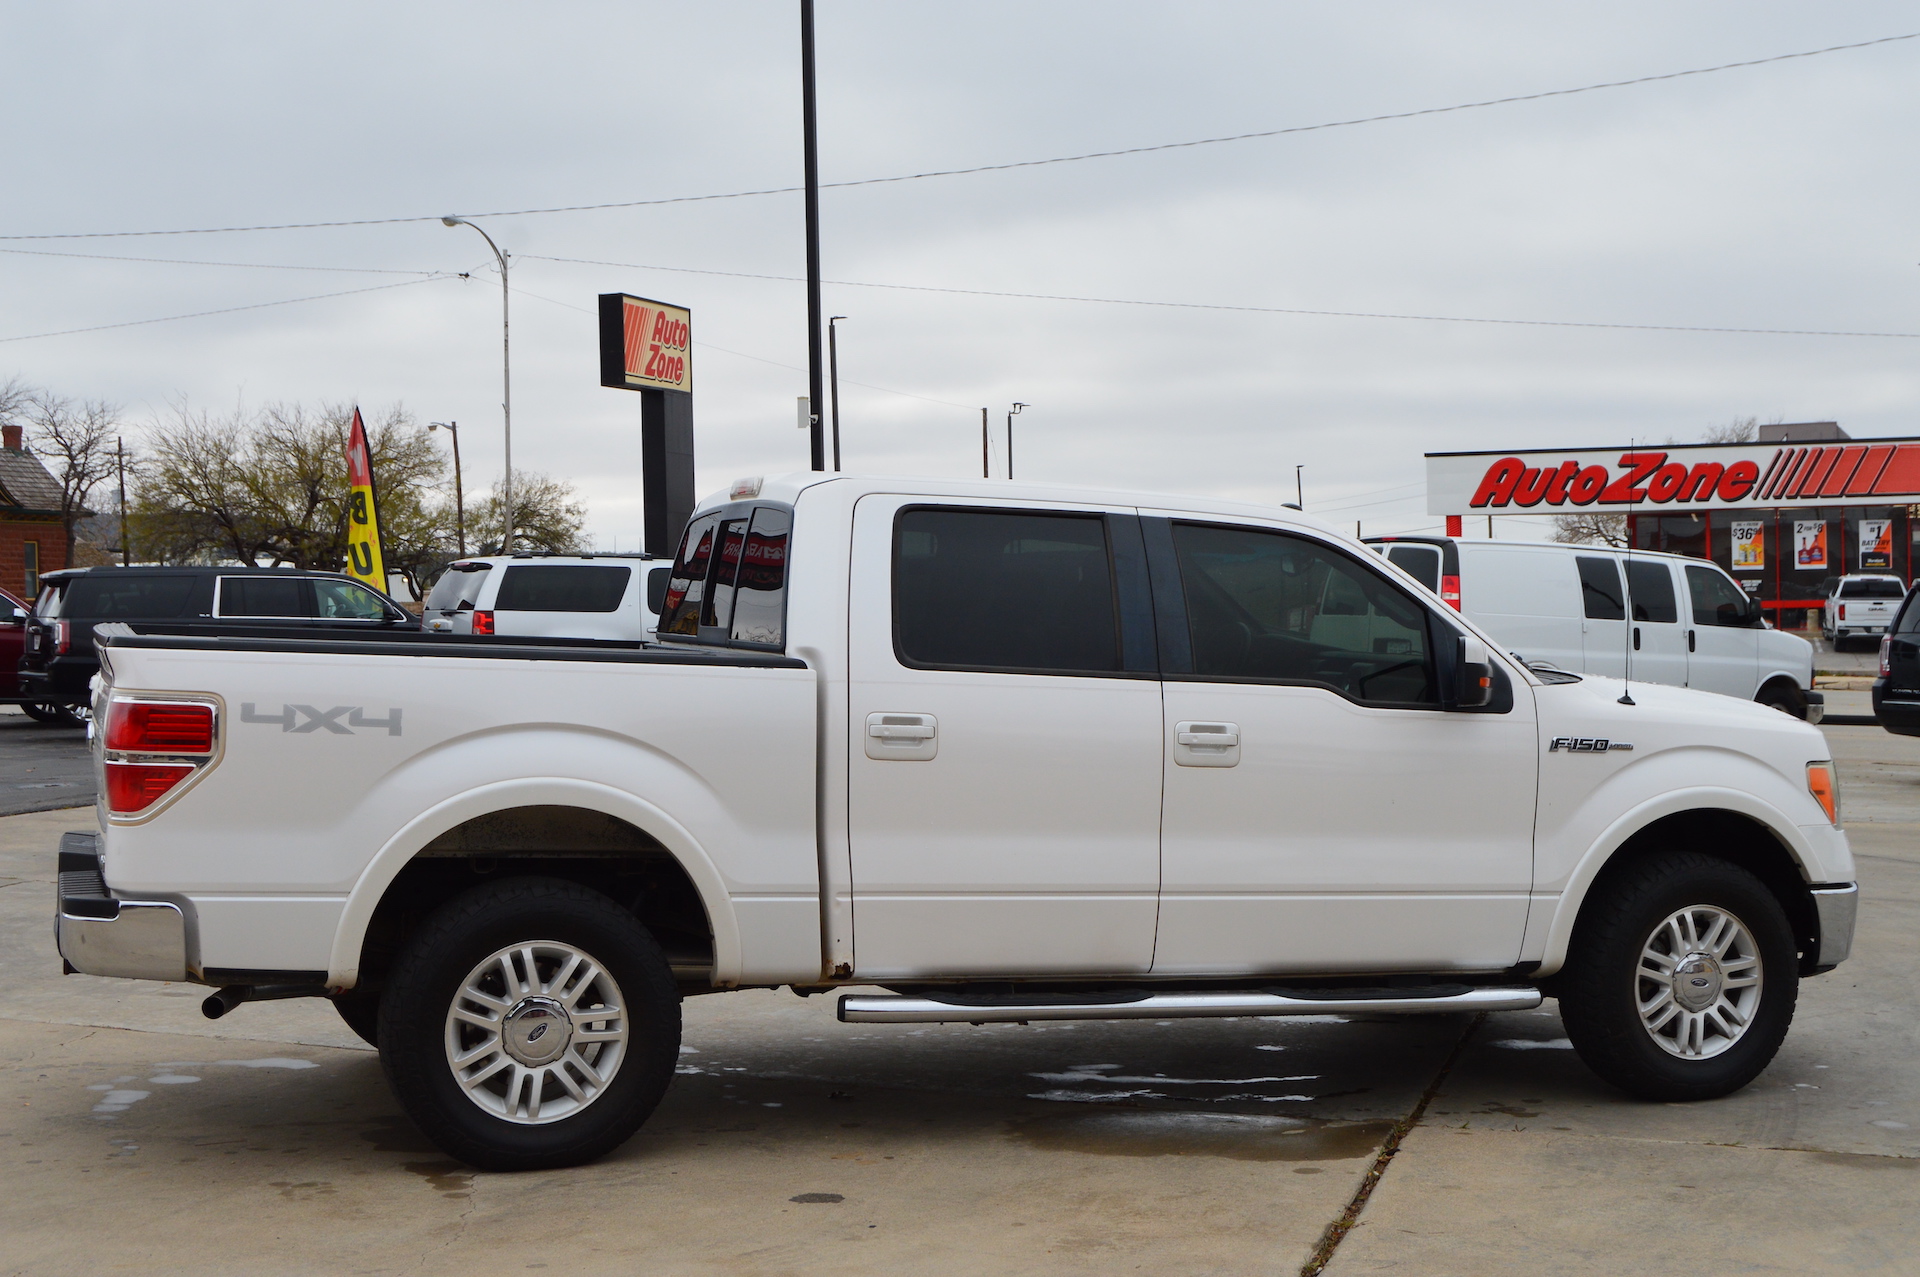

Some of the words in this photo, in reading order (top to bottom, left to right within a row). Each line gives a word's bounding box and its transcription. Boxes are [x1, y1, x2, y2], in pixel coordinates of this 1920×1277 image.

[652, 310, 689, 350] Auto
[644, 343, 685, 383] Zone
[1470, 452, 1760, 508] AutoZone
[1796, 523, 1804, 534] 2
[1861, 539, 1891, 547] BATTERY
